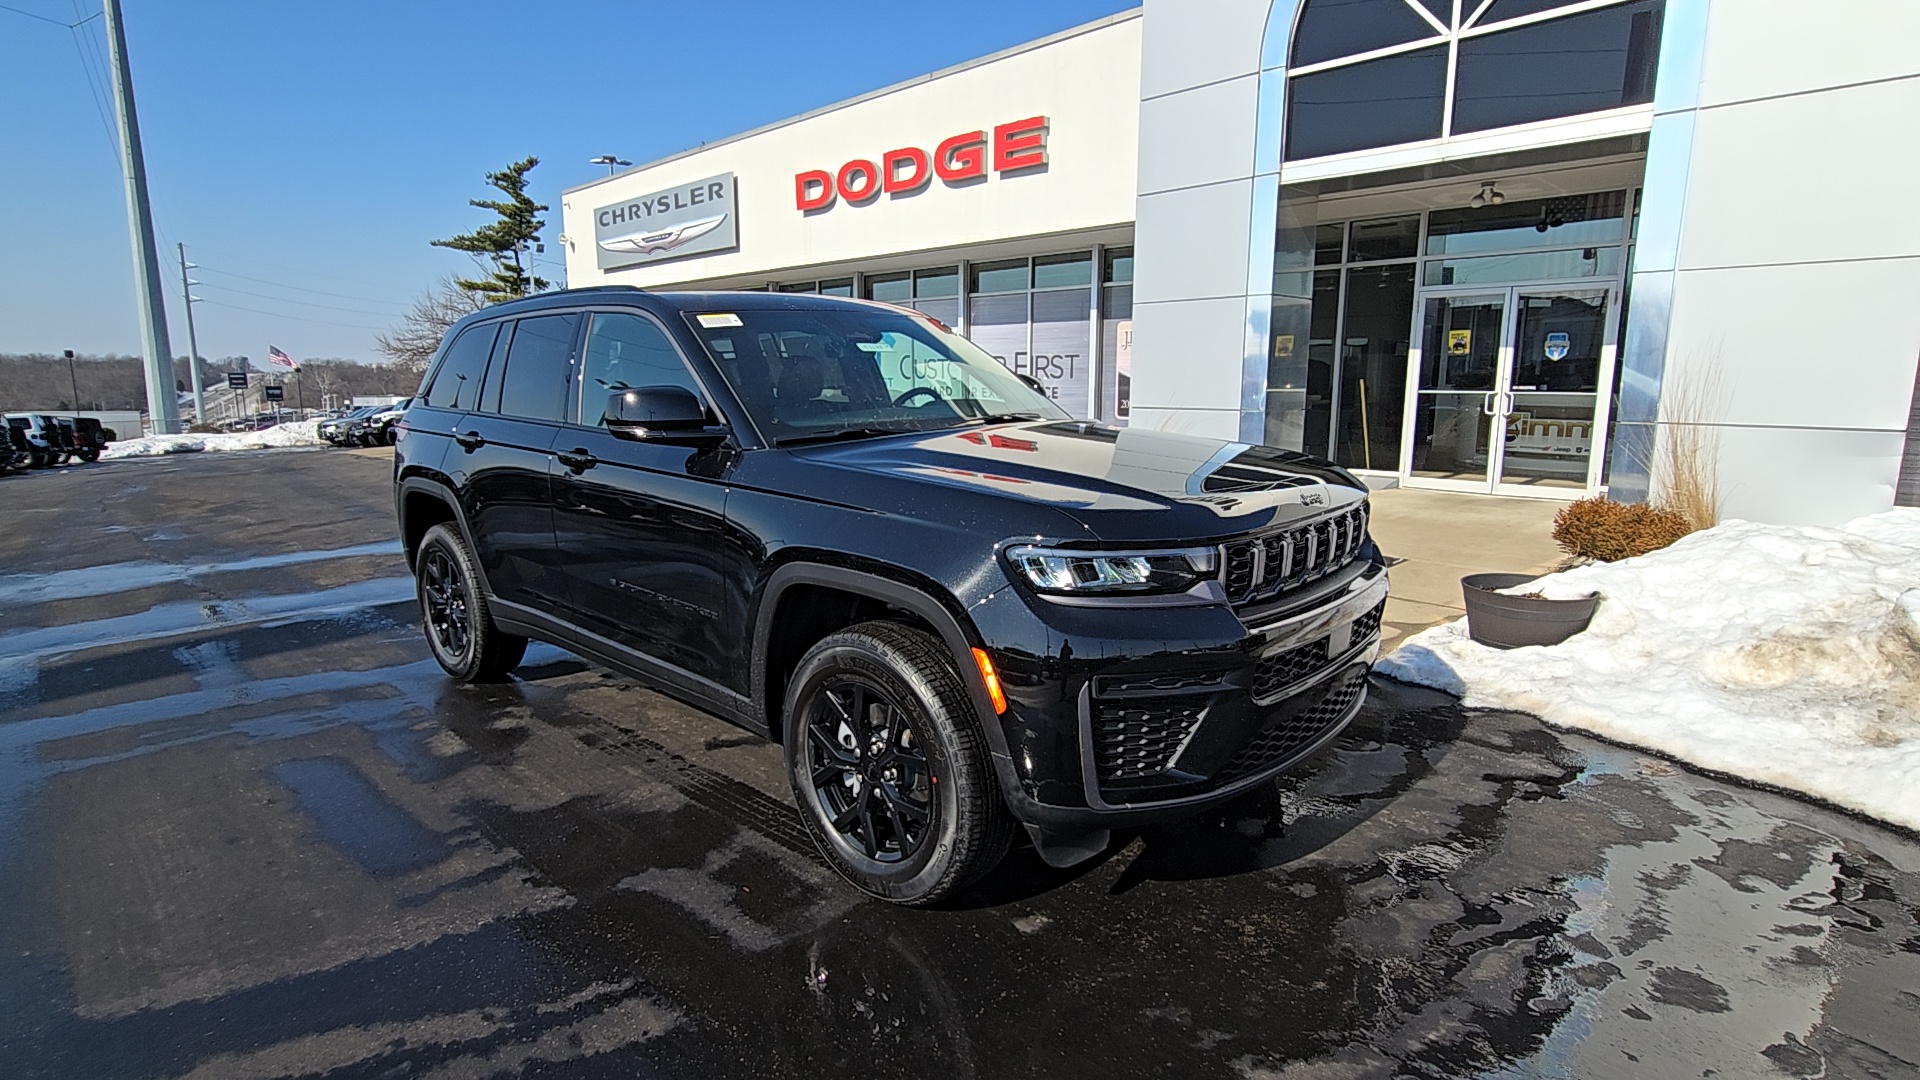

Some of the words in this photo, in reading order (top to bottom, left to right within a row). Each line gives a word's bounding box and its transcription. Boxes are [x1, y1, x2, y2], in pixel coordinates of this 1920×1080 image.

[795, 116, 1046, 211] DODGE
[599, 182, 724, 227] CHRYSLER
[1014, 351, 1080, 379] FIRST
[1506, 412, 1616, 440] Zimm
